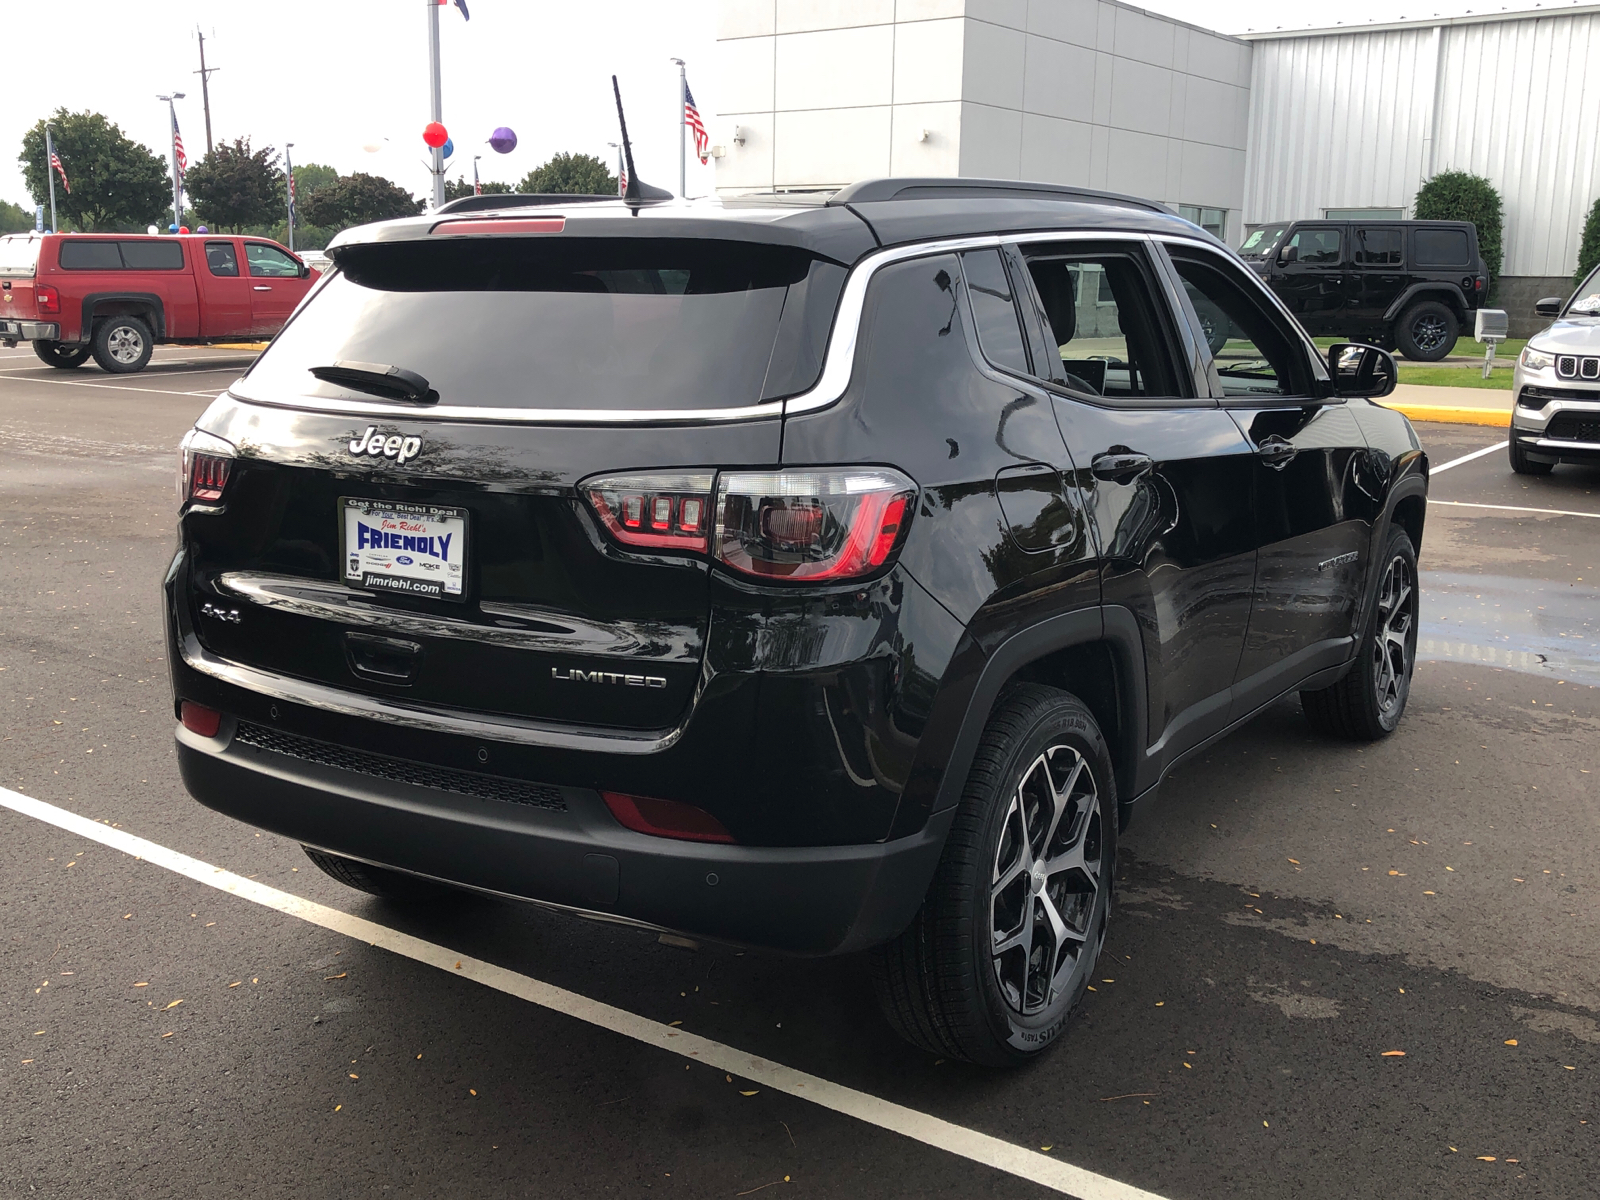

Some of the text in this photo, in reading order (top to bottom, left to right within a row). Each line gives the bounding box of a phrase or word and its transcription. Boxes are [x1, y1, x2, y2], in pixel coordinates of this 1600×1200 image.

[349, 425, 422, 466] Jeep
[348, 499, 457, 516] Get the Riehl Deal
[381, 511, 395, 520] Your
[381, 519, 427, 533] Jim Riehl's
[357, 521, 453, 562] FRIENDLY
[419, 562, 441, 570] MOKE
[365, 575, 440, 594] jimriehl.com
[551, 667, 667, 689] LIMITED
